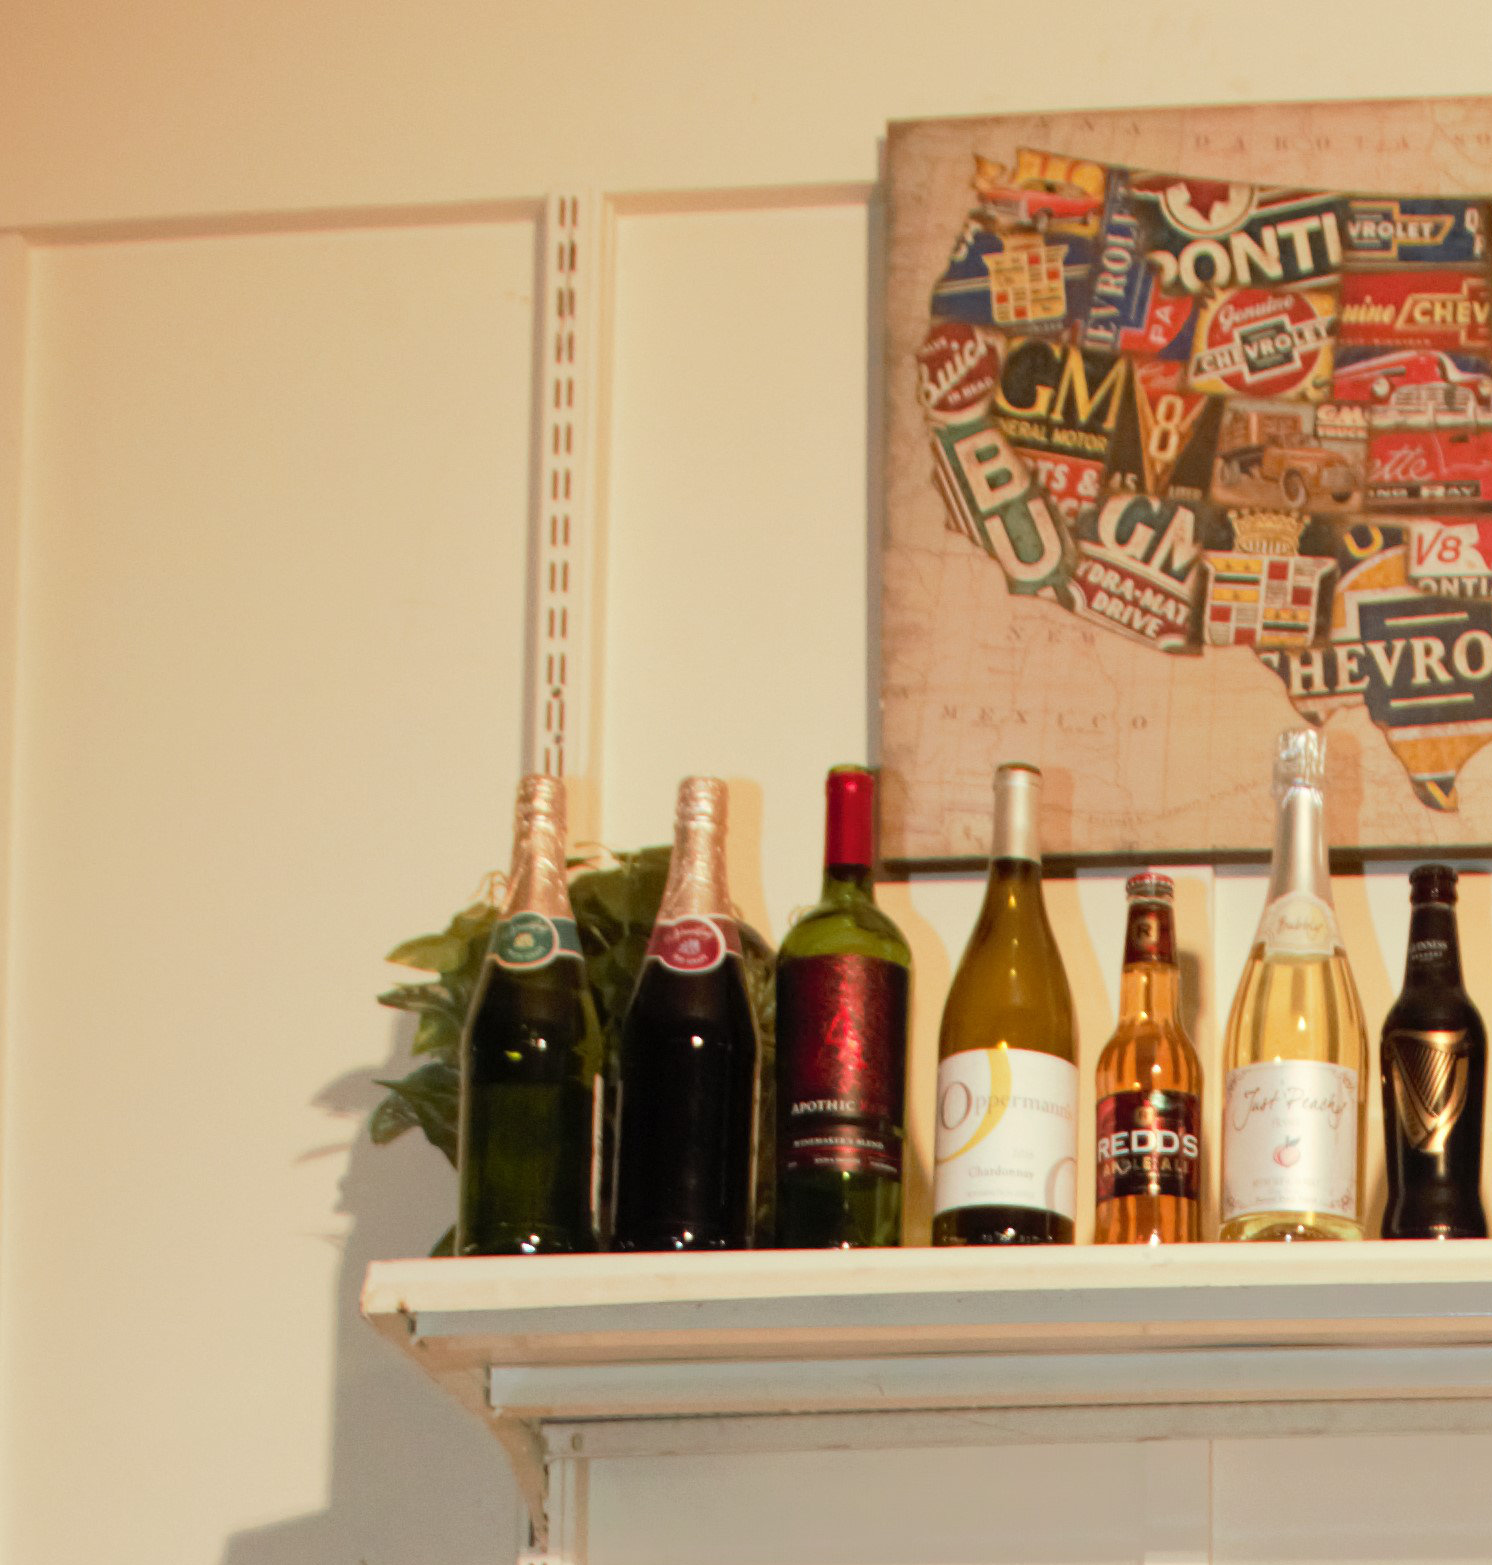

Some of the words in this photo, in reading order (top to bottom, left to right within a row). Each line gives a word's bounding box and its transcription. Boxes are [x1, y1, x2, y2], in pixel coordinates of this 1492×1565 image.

[1413, 300, 1491, 325] CHEV
[995, 335, 1129, 431] GM
[1416, 533, 1463, 566] V8
[1091, 590, 1164, 638] DRIVE
[791, 1100, 856, 1116] APOTHIC
